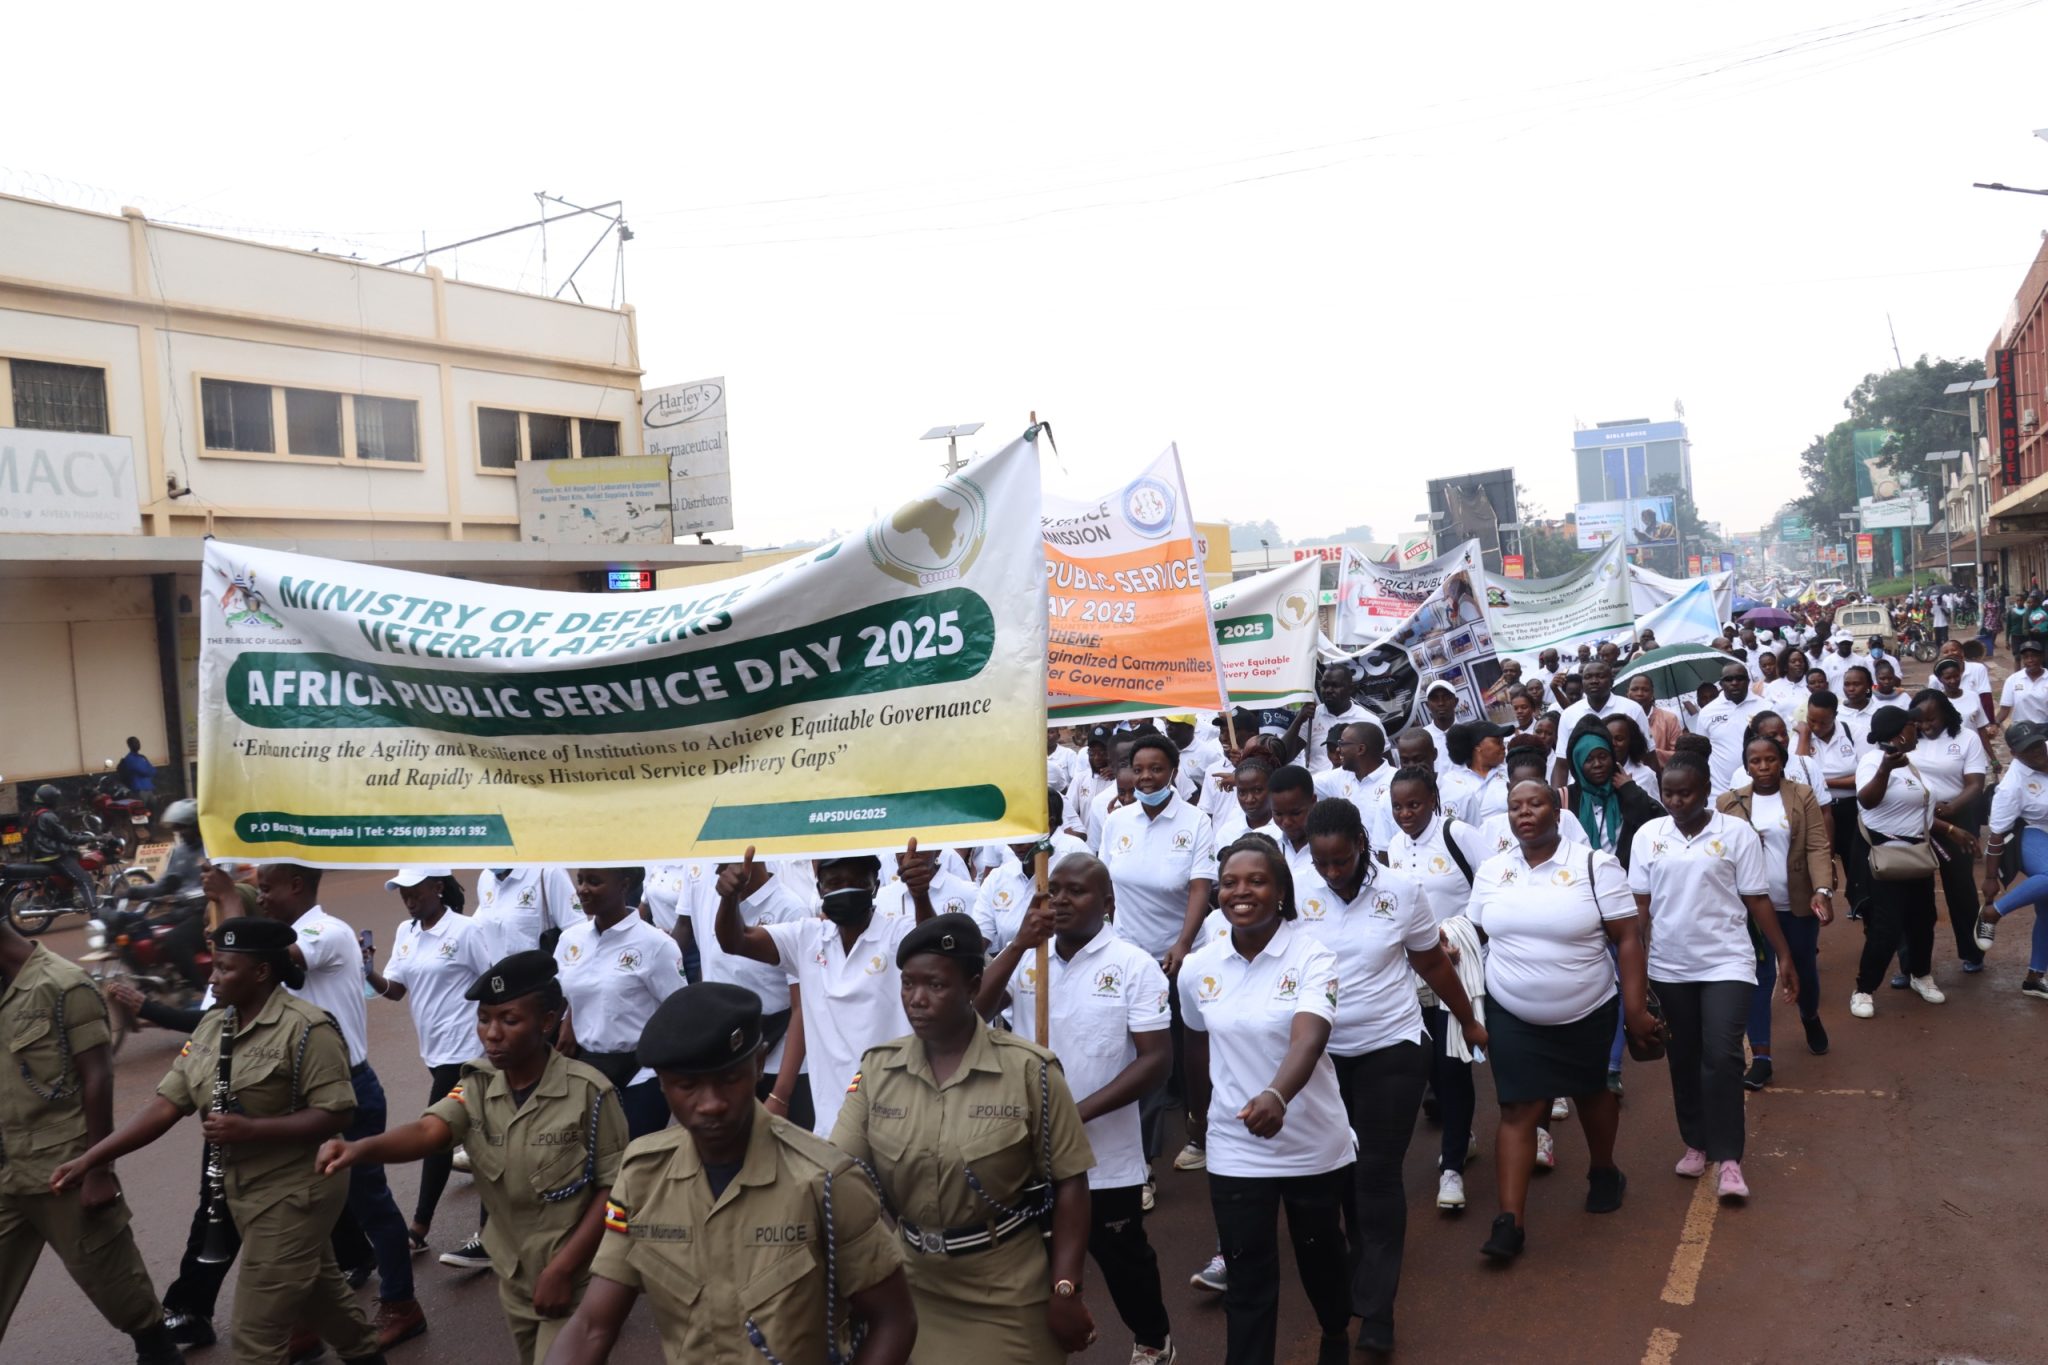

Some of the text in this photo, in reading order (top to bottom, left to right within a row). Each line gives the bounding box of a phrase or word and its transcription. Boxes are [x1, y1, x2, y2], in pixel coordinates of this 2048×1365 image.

[659, 384, 711, 410] Harley's
[2000, 351, 2017, 485] JELIZA HOTEL
[649, 431, 722, 457] Pharmaceutical
[681, 493, 729, 511] Distributors
[1113, 557, 1201, 594] SERVICE
[279, 575, 750, 635] MINISTRY OF DEFENCE
[1080, 599, 1137, 624] 2025
[358, 610, 734, 659] VETERAN AFFAIRS
[1050, 629, 1103, 649] THEME:
[1223, 622, 1265, 639] 2025
[207, 637, 223, 645] THE
[255, 637, 266, 645] OF
[268, 638, 303, 646] UGANDA
[248, 610, 964, 719] AFRICA PUBLIC SERVICE DAY 2025
[1047, 650, 1213, 674] ginalized Communities
[1247, 655, 1291, 667] Equitable
[1047, 667, 1066, 680] er
[1711, 714, 1729, 723] UBC
[336, 740, 364, 759] the
[369, 739, 430, 763] Agility
[434, 741, 466, 757] and
[469, 743, 548, 762] Resilience
[552, 744, 570, 764] of
[574, 739, 677, 760] Institutions
[681, 739, 700, 753] to
[706, 724, 784, 752] Achieve
[791, 708, 875, 741] Equitable
[879, 697, 992, 727] Governance
[365, 769, 400, 787] and
[404, 767, 474, 790] Rapidly
[477, 767, 545, 786] Address
[550, 764, 636, 785] Historical
[641, 761, 707, 781] Service
[712, 753, 786, 777] Delivery
[807, 806, 888, 824] #APSDUG2025
[272, 822, 288, 833] Box
[307, 826, 354, 839] Kampala
[363, 825, 385, 837] Tel:
[386, 825, 412, 837] +256
[413, 825, 427, 838] (0)
[428, 825, 447, 837] 393
[448, 825, 466, 837] 261
[467, 825, 488, 837] 392
[247, 1046, 281, 1058] POLICE
[975, 1104, 1021, 1118] POLICE
[538, 1130, 579, 1145] POLICE
[755, 1224, 808, 1243] POLICE
